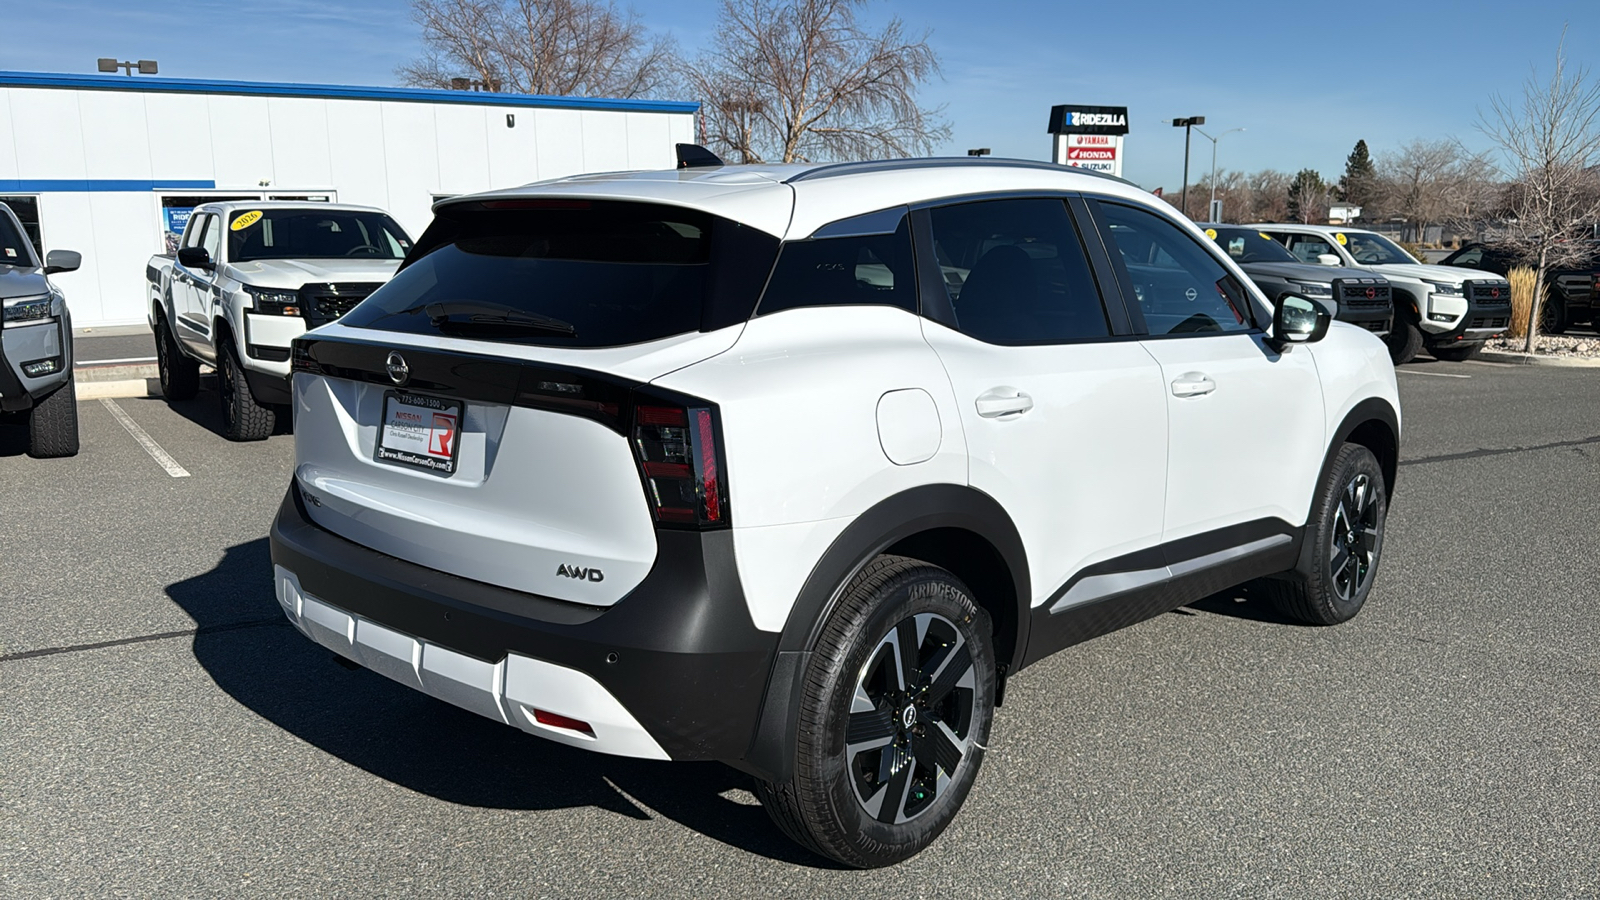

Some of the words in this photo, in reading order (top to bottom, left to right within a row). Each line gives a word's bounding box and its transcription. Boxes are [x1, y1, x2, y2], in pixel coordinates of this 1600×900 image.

[1080, 113, 1126, 126] RIDEZILLA
[1084, 136, 1109, 145] YAMAHA
[1079, 151, 1113, 159] HONDA
[1081, 163, 1112, 171] SUZUKI
[236, 212, 258, 228] 2026
[401, 395, 441, 408] 775-600-1500
[395, 411, 423, 422] NISSAN
[391, 420, 412, 431] CARSON
[412, 424, 426, 433] CITY
[384, 451, 447, 469] www.NissanCarsonCity.com
[556, 563, 604, 583] AWD
[908, 582, 978, 618] BRIDGESTONE
